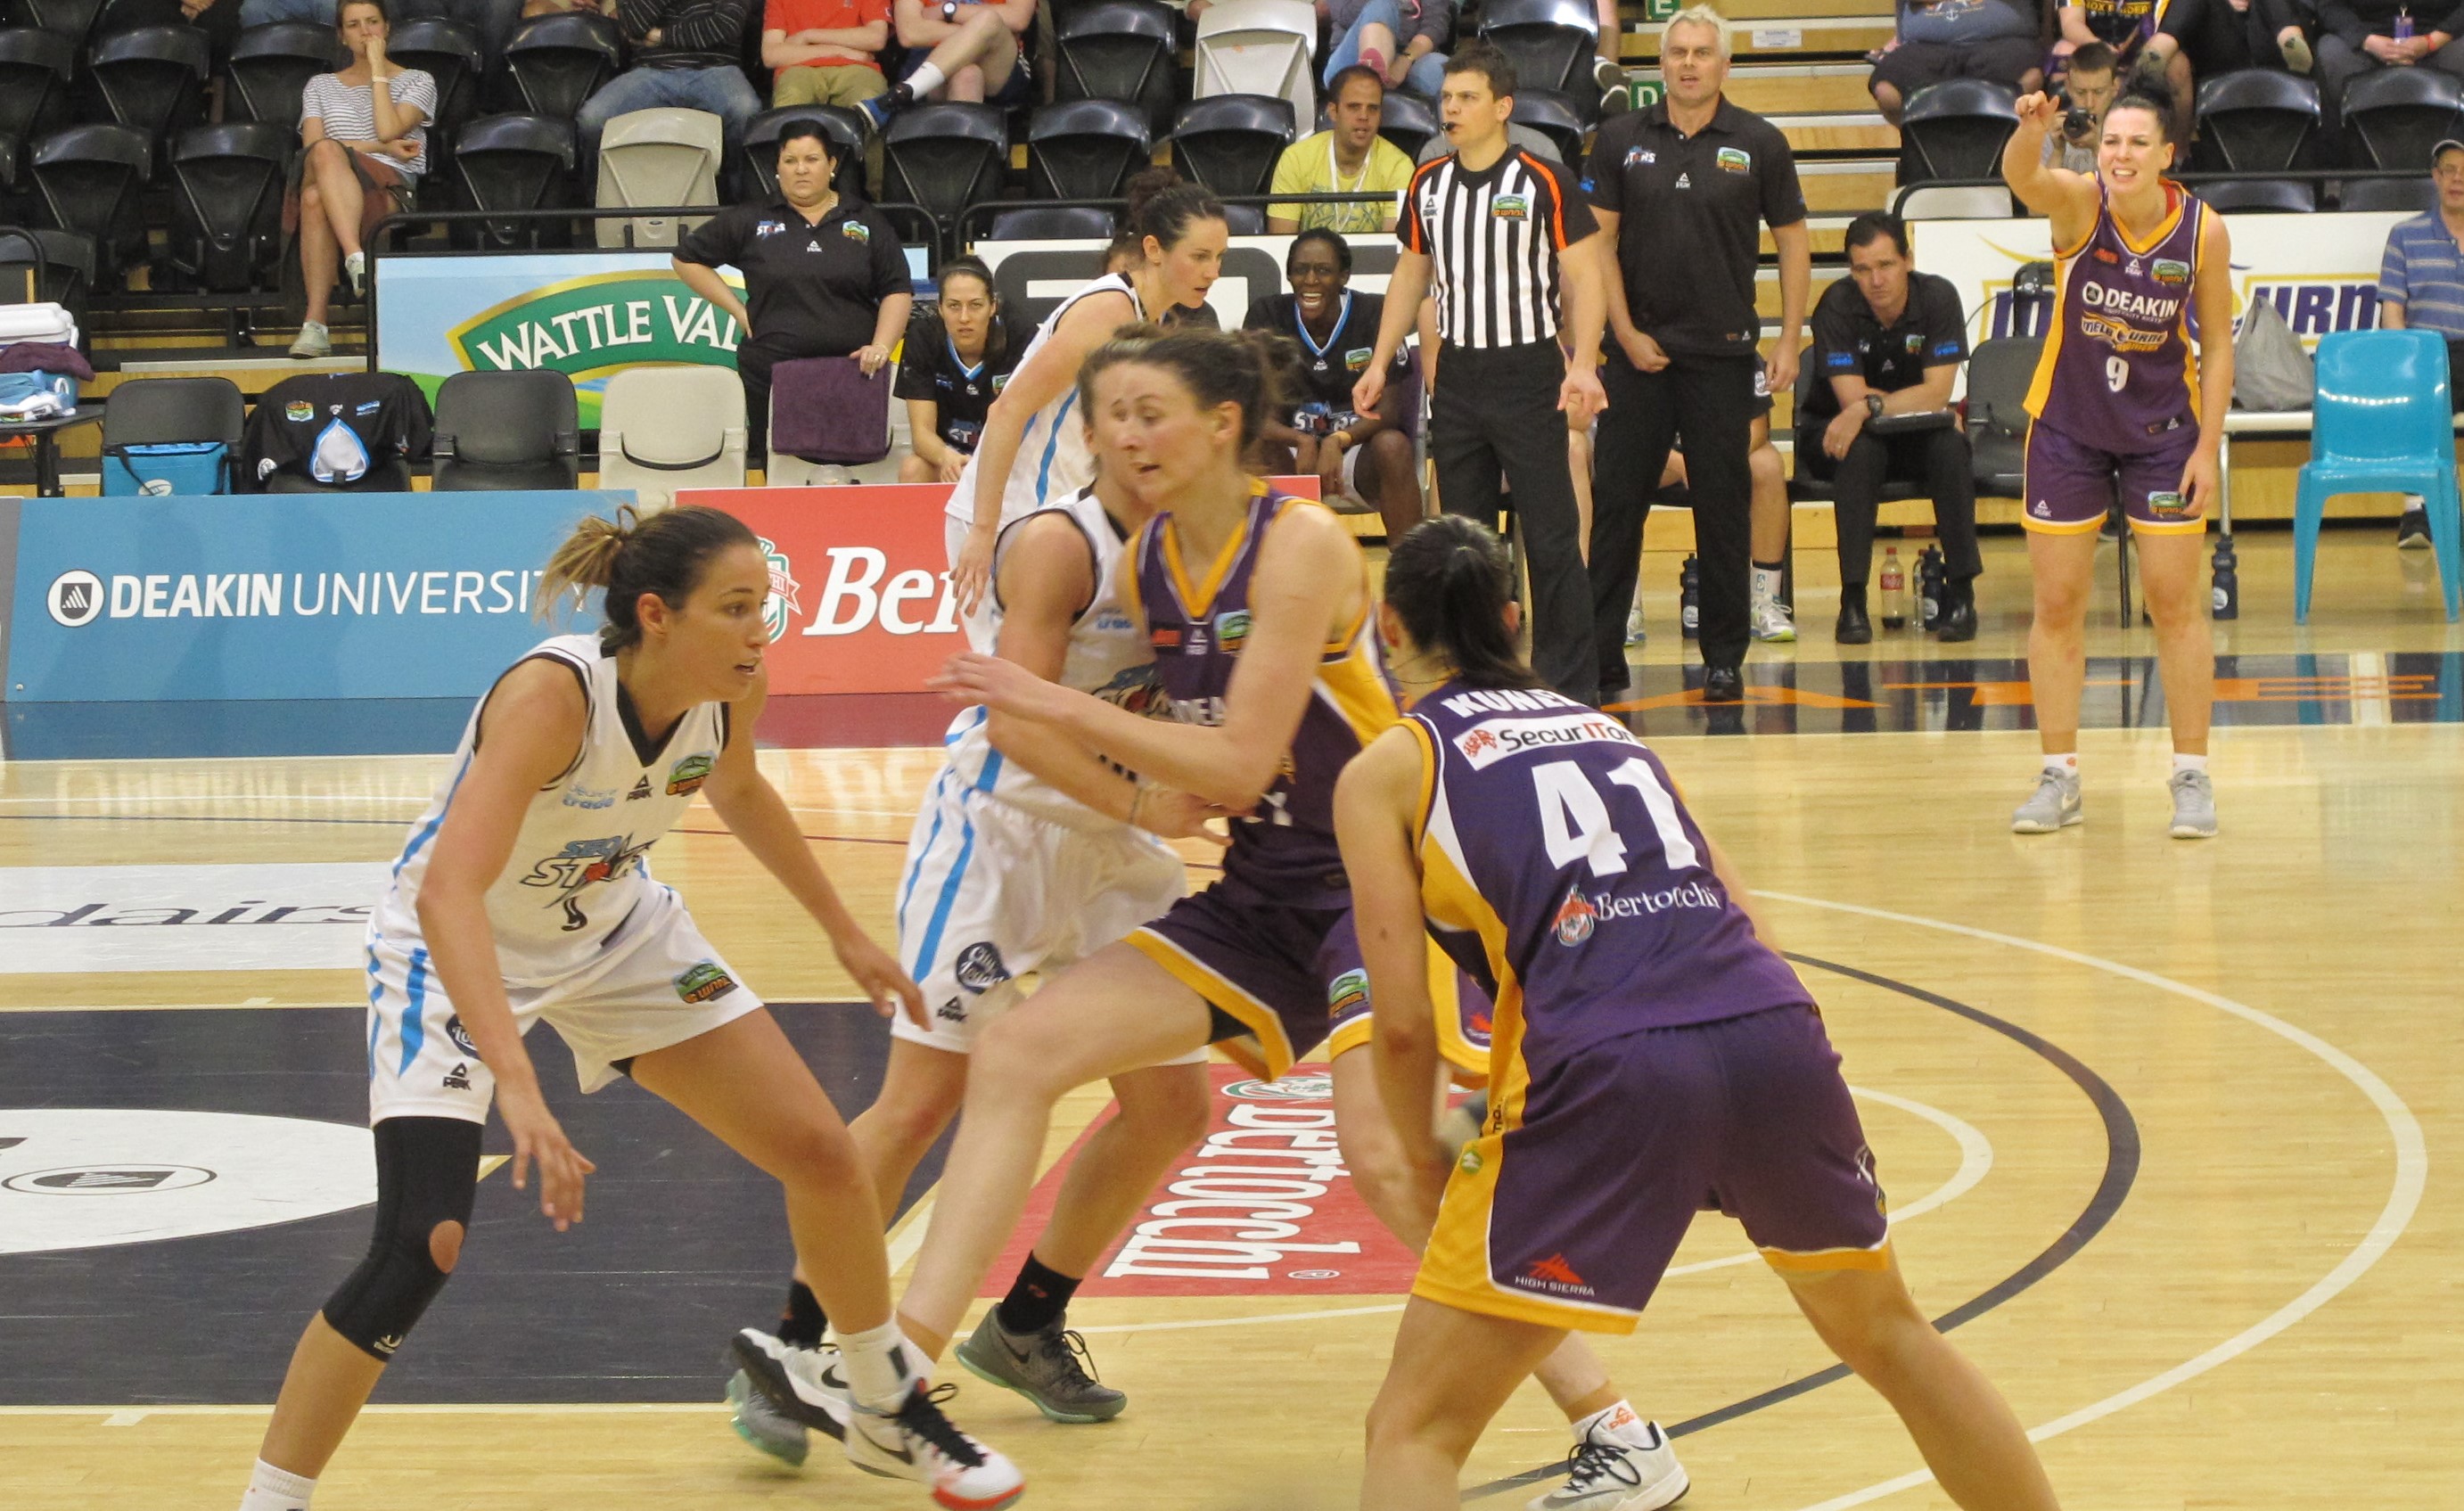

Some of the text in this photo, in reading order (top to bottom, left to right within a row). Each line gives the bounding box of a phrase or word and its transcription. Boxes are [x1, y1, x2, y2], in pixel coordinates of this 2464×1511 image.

[2106, 288, 2180, 317] DEAKIN
[476, 295, 737, 371] WATTLE VAL
[2105, 356, 2131, 392] 9
[110, 570, 585, 618] DEAKIN UNIVERSI
[1532, 757, 1702, 877] 41
[1595, 881, 1721, 922] Bertocchi
[1515, 1276, 1596, 1298] HIGH SIERRA
